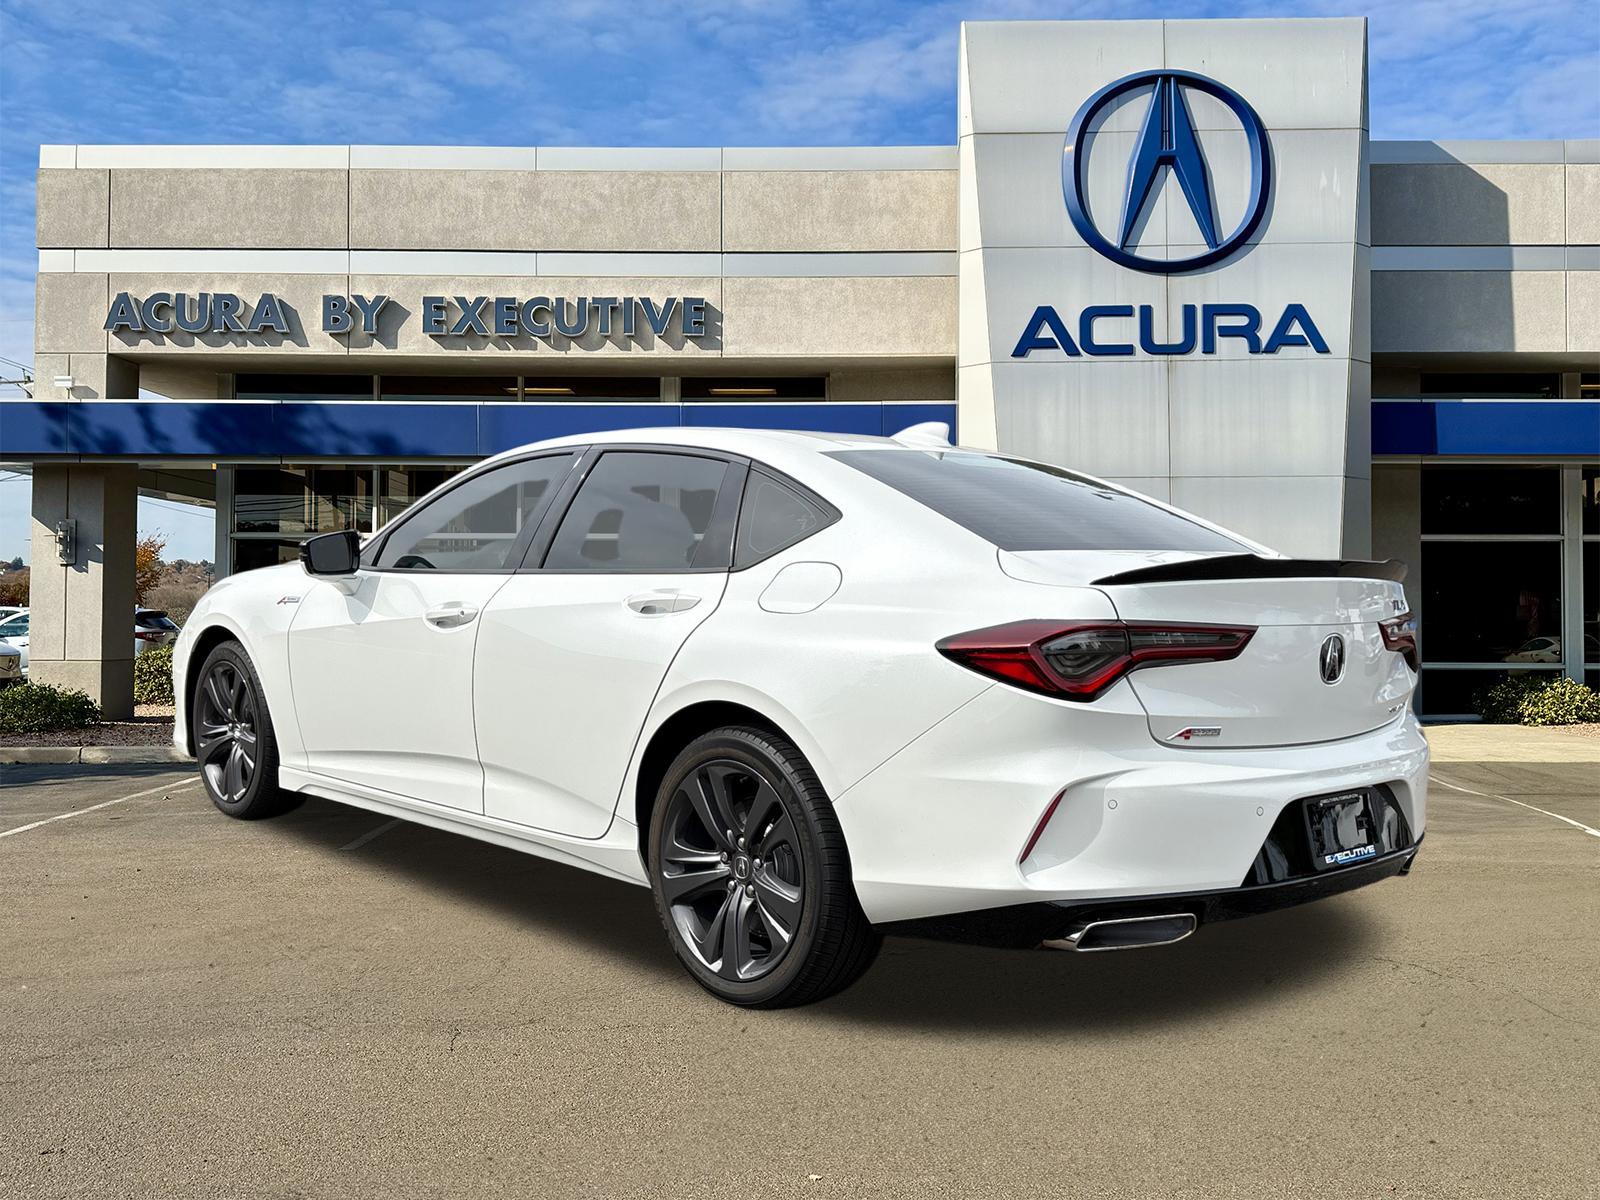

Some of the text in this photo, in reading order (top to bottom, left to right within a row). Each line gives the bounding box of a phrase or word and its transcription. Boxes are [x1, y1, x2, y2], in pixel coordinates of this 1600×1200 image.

[103, 291, 706, 337] ACURA BY EXECUTIVE
[1010, 303, 1333, 357] ACURA
[1325, 844, 1376, 864] EXECUTIVE
